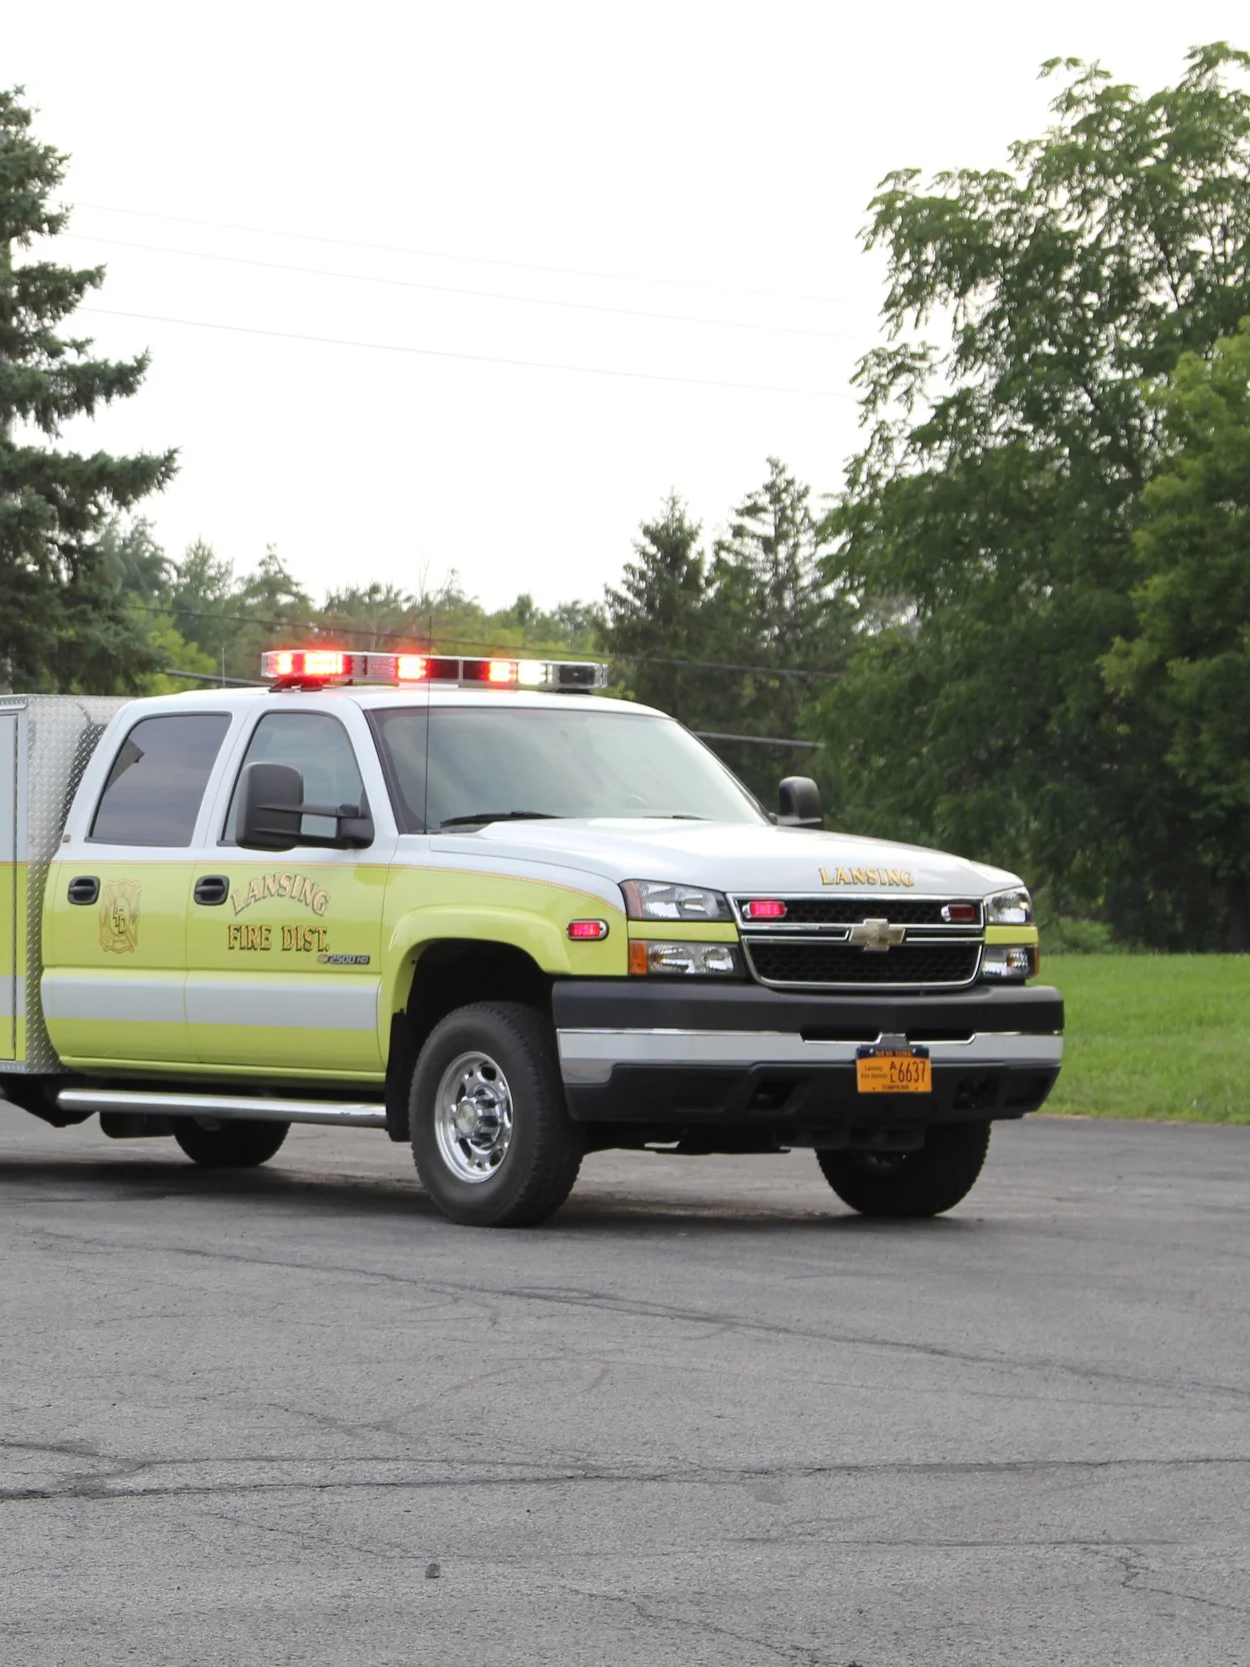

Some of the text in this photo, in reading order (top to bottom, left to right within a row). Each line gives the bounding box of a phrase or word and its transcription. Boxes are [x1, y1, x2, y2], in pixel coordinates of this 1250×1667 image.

[818, 867, 915, 888] LANSING
[231, 872, 330, 917] LANSING
[228, 924, 330, 953] FIRE DIST.
[330, 955, 356, 964] 2500
[898, 1061, 926, 1083] 6637
